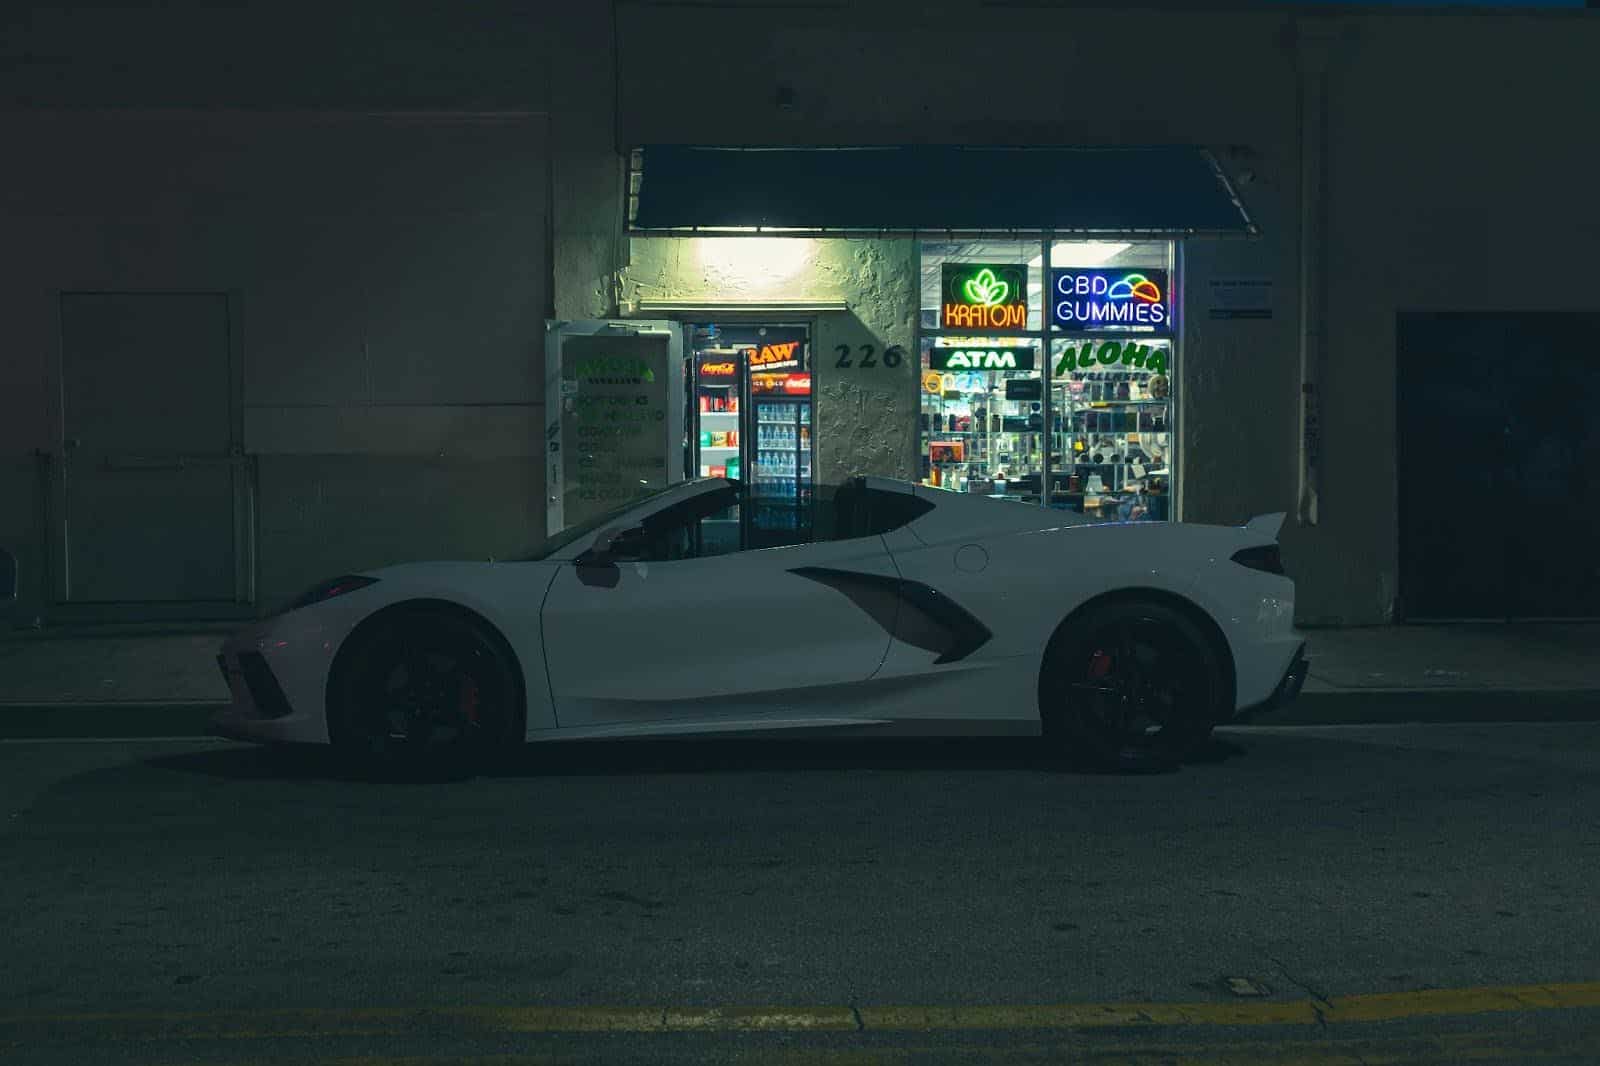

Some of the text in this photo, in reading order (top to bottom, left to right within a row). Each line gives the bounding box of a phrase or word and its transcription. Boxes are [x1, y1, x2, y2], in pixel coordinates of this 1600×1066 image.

[1057, 275, 1108, 295] CBD
[945, 303, 1026, 327] KRATOM
[1056, 301, 1165, 323] GUMMIES
[749, 343, 795, 364] RAW
[833, 344, 902, 368] 226
[947, 351, 1016, 367] ATM
[1055, 341, 1166, 377] ALOHA
